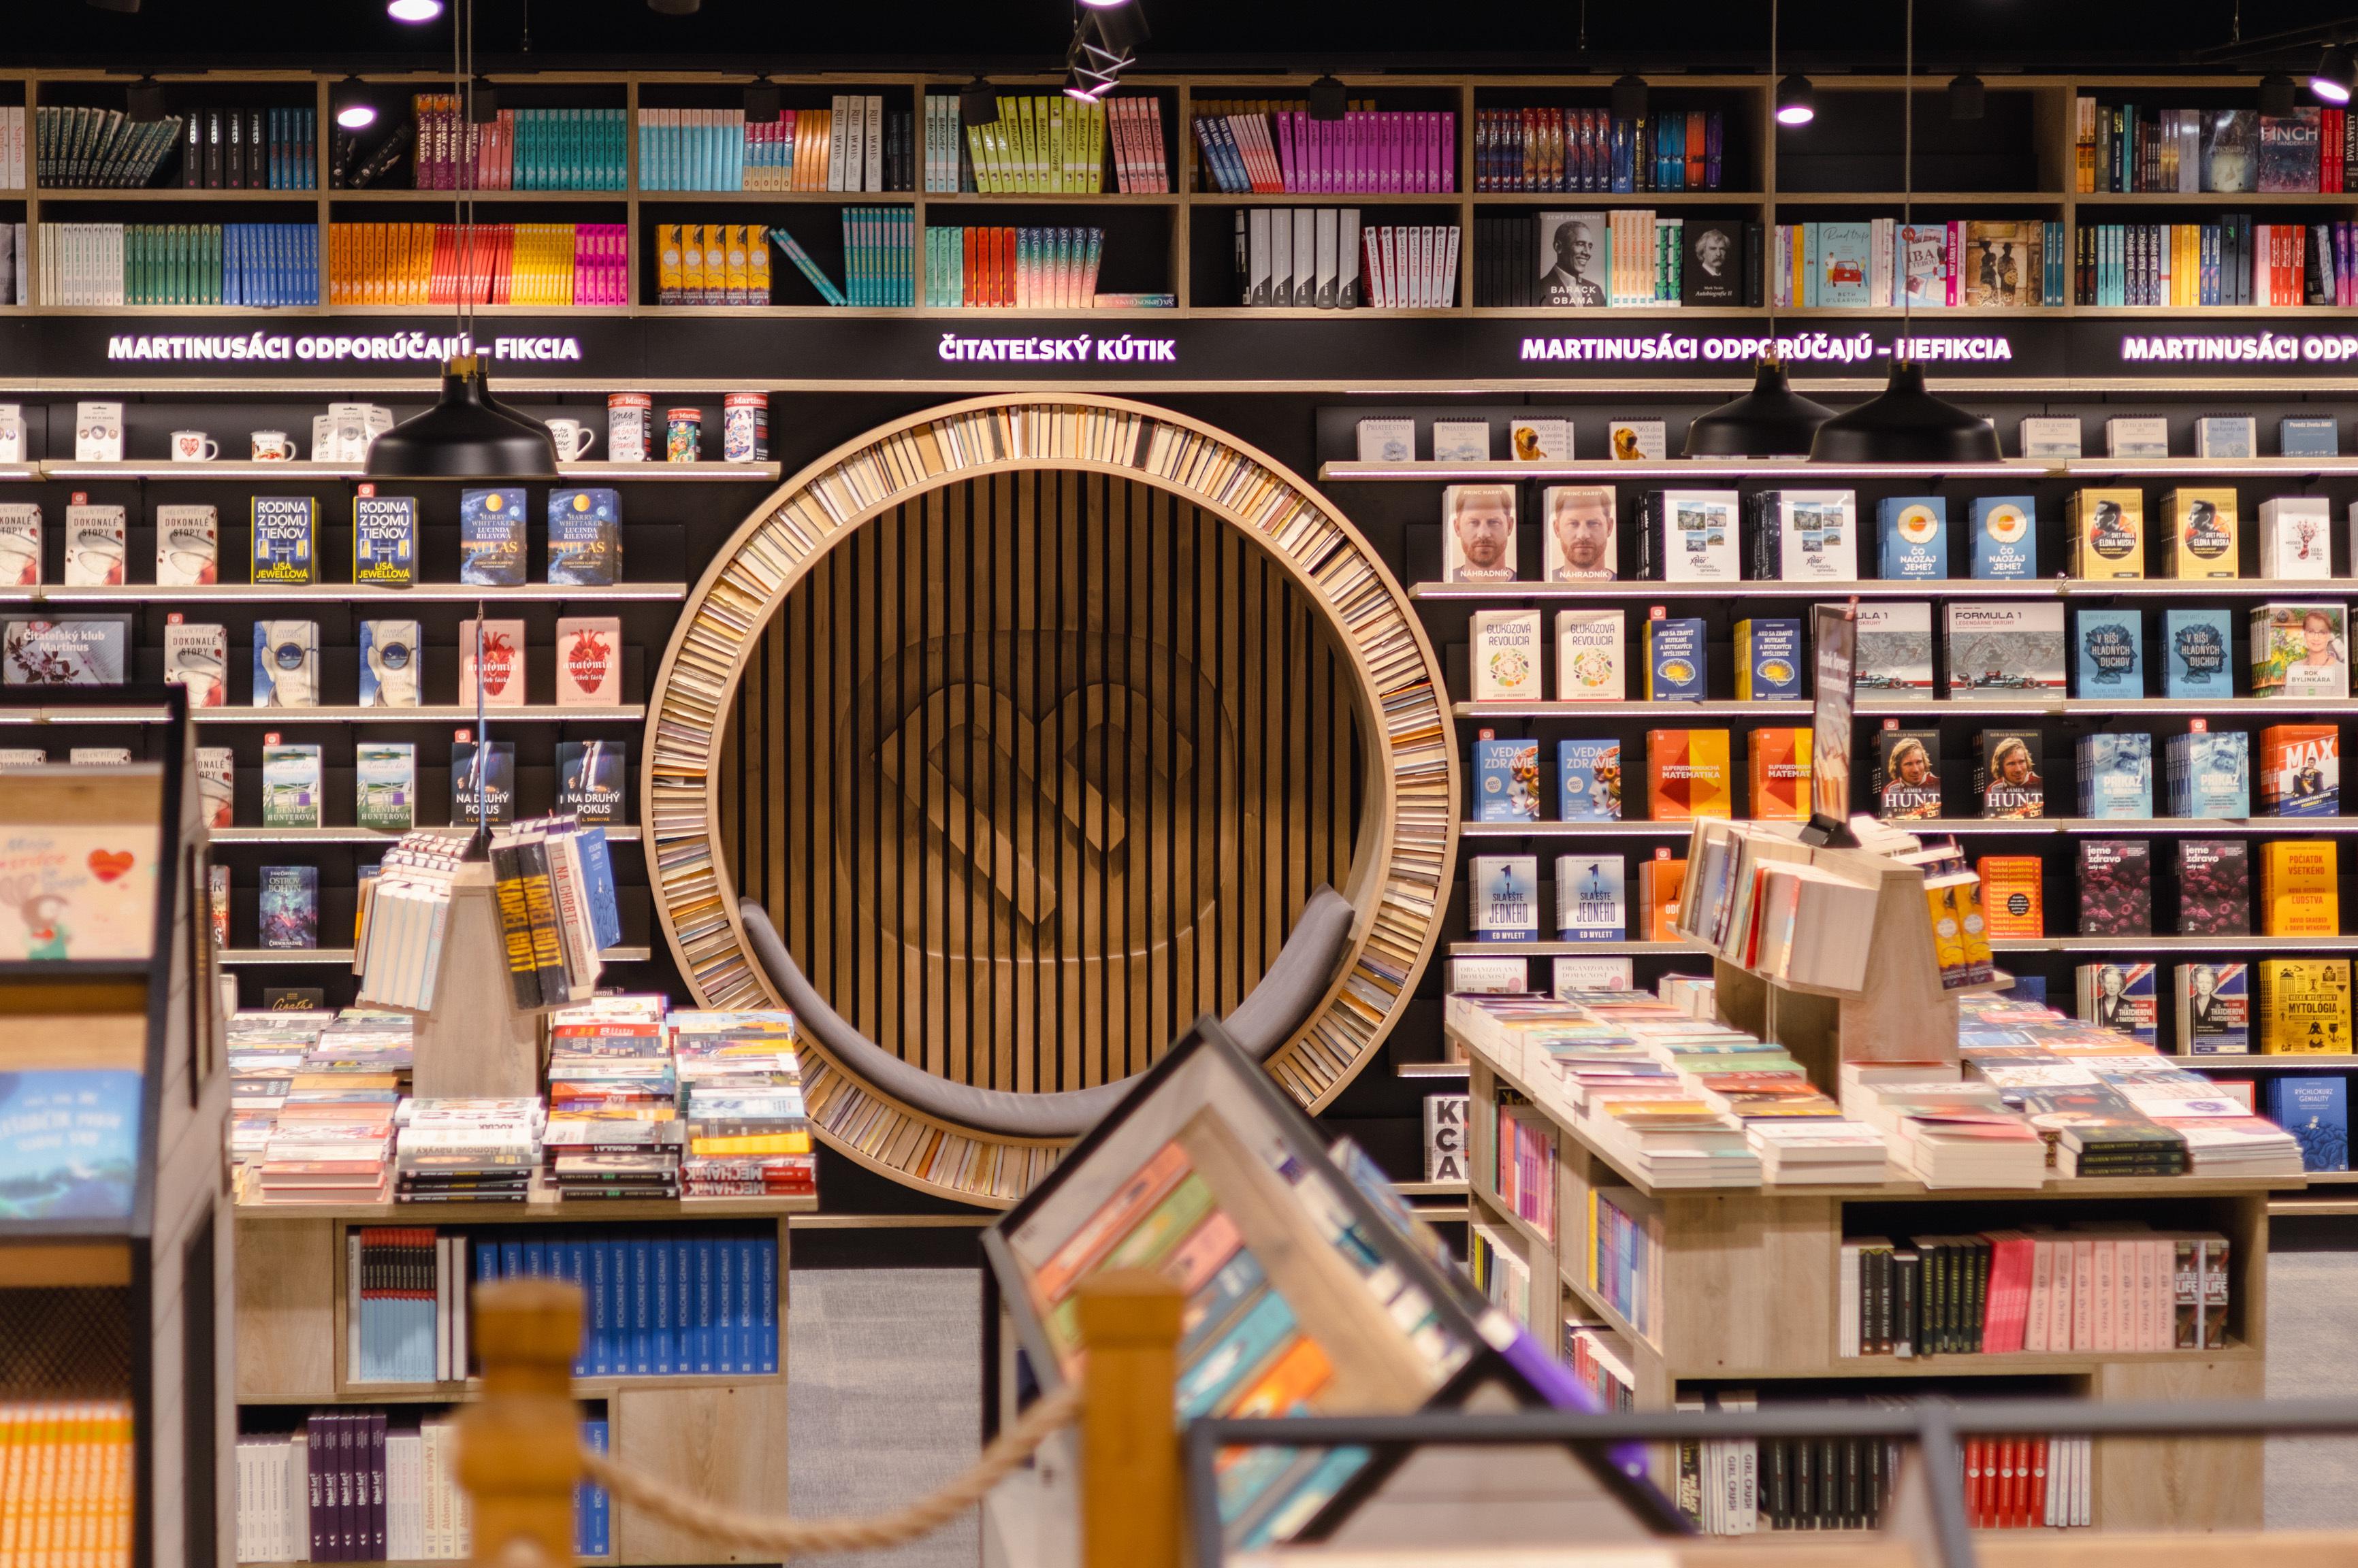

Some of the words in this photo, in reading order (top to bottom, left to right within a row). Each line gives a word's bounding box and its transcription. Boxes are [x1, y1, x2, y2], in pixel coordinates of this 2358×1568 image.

[785, 121, 793, 142] Beach
[1195, 119, 1205, 133] THIS
[1200, 133, 1210, 147] GIRL
[1218, 118, 1228, 132] THIS
[1223, 133, 1233, 147] GIRL
[2261, 126, 2318, 141] FINCH
[2346, 114, 2355, 142] SVETY
[784, 143, 793, 161] Read
[833, 135, 844, 160] WOLVES
[870, 135, 879, 161] WOLVES
[2346, 142, 2355, 161] DVA
[1551, 286, 1596, 294] BARACK
[1553, 296, 1594, 305] OBAMA
[108, 333, 289, 360] MARTINUSÁCI
[295, 331, 471, 363] ODPORÚČAJÚ
[496, 338, 580, 359] FIKCIA
[939, 333, 1091, 360] ČITATEĽSKÝ
[1097, 334, 1176, 360] KÚTIK
[1521, 333, 1698, 360] MARTINUSÁCI
[1897, 338, 2012, 359] NEFIKCIA
[2123, 333, 2298, 359] MARTINUSÁCI
[257, 502, 307, 513] RODINA
[359, 502, 409, 513] RODINA
[74, 517, 118, 527] DOKONALÉ
[257, 515, 266, 526] Z
[268, 514, 307, 526] DOMU
[359, 515, 368, 526] Z
[370, 514, 410, 526] DOMU
[82, 528, 110, 537] STOPY
[259, 524, 306, 539] TIEŇOV
[361, 524, 408, 539] TIEŇOV
[468, 541, 518, 554] ATLAS
[2099, 538, 2117, 546] ELONA
[1911, 546, 1926, 555] ČO
[256, 568, 308, 578] JEWELLOVÁ
[358, 568, 410, 578] JEWELLOVÁ
[1905, 562, 1933, 571] JEME?
[1460, 569, 1509, 578] NÁHRADNÍK
[1560, 570, 1609, 578] NÁHRADNÍK
[1955, 612, 2014, 620] FORMULA
[1487, 621, 1532, 634] GLUKÓZOVÁ
[23, 628, 80, 643] Čitateľský
[81, 630, 106, 641] klub
[172, 636, 217, 646] DOKONALÉ
[1489, 633, 1530, 647] REVOLÚCIA
[2097, 634, 2103, 644] V
[2104, 632, 2120, 644] RÍŠI
[39, 642, 90, 653] Martinus
[181, 647, 208, 656] STOPY
[2092, 643, 2131, 656] HLADNÝCH
[563, 658, 613, 670] anatómia
[2100, 657, 2131, 667] DUCHOV
[2291, 674, 2332, 683] BYLINKÁRA
[1490, 747, 1521, 757] VEDA
[2286, 737, 2335, 770] MAX
[1485, 758, 1534, 769] ZDRAVIE
[1662, 771, 1721, 779] MATEMATIKA
[568, 793, 582, 803] NA
[584, 790, 621, 803] DRUHÝ
[1885, 794, 1940, 808] HUNT
[276, 806, 306, 814] DENISE
[577, 804, 611, 815] POKUS
[268, 813, 316, 821] HUNTEROVÁ
[2088, 846, 2111, 857] jeme
[2088, 853, 2121, 863] zdravo
[2289, 853, 2323, 864] POČIATOK
[555, 866, 570, 881] NA
[2288, 864, 2325, 875] VŠETKÉHO
[269, 877, 300, 885] OSTROV
[523, 874, 556, 927] KAREL
[1493, 893, 1507, 902] SILA
[1508, 892, 1524, 902] EŠTE
[496, 878, 529, 930] KAREL
[560, 885, 578, 926] CHRBTE
[1489, 902, 1528, 924] JEDNÉHO
[1492, 932, 1500, 940] ED
[1502, 932, 1525, 940] MYLETT
[504, 931, 536, 973] GOTT
[531, 927, 564, 968] GOTT
[2119, 1007, 2153, 1016] THATCHEROVÁ
[2289, 1000, 2338, 1013] MYTOLÓGIA
[683, 1166, 762, 1182] MECHANIK
[688, 1181, 766, 1196] MECHANIK
[595, 1249, 603, 1284] GENIALITY
[763, 1247, 771, 1282] GENIALITY
[2176, 1273, 2198, 1282] LITTLE
[2176, 1281, 2198, 1294] LIFE
[426, 1446, 436, 1486] návyky
[1743, 1454, 1752, 1476] GIRL
[1743, 1479, 1752, 1509] CRUSH
[425, 1488, 435, 1531] Atómové
